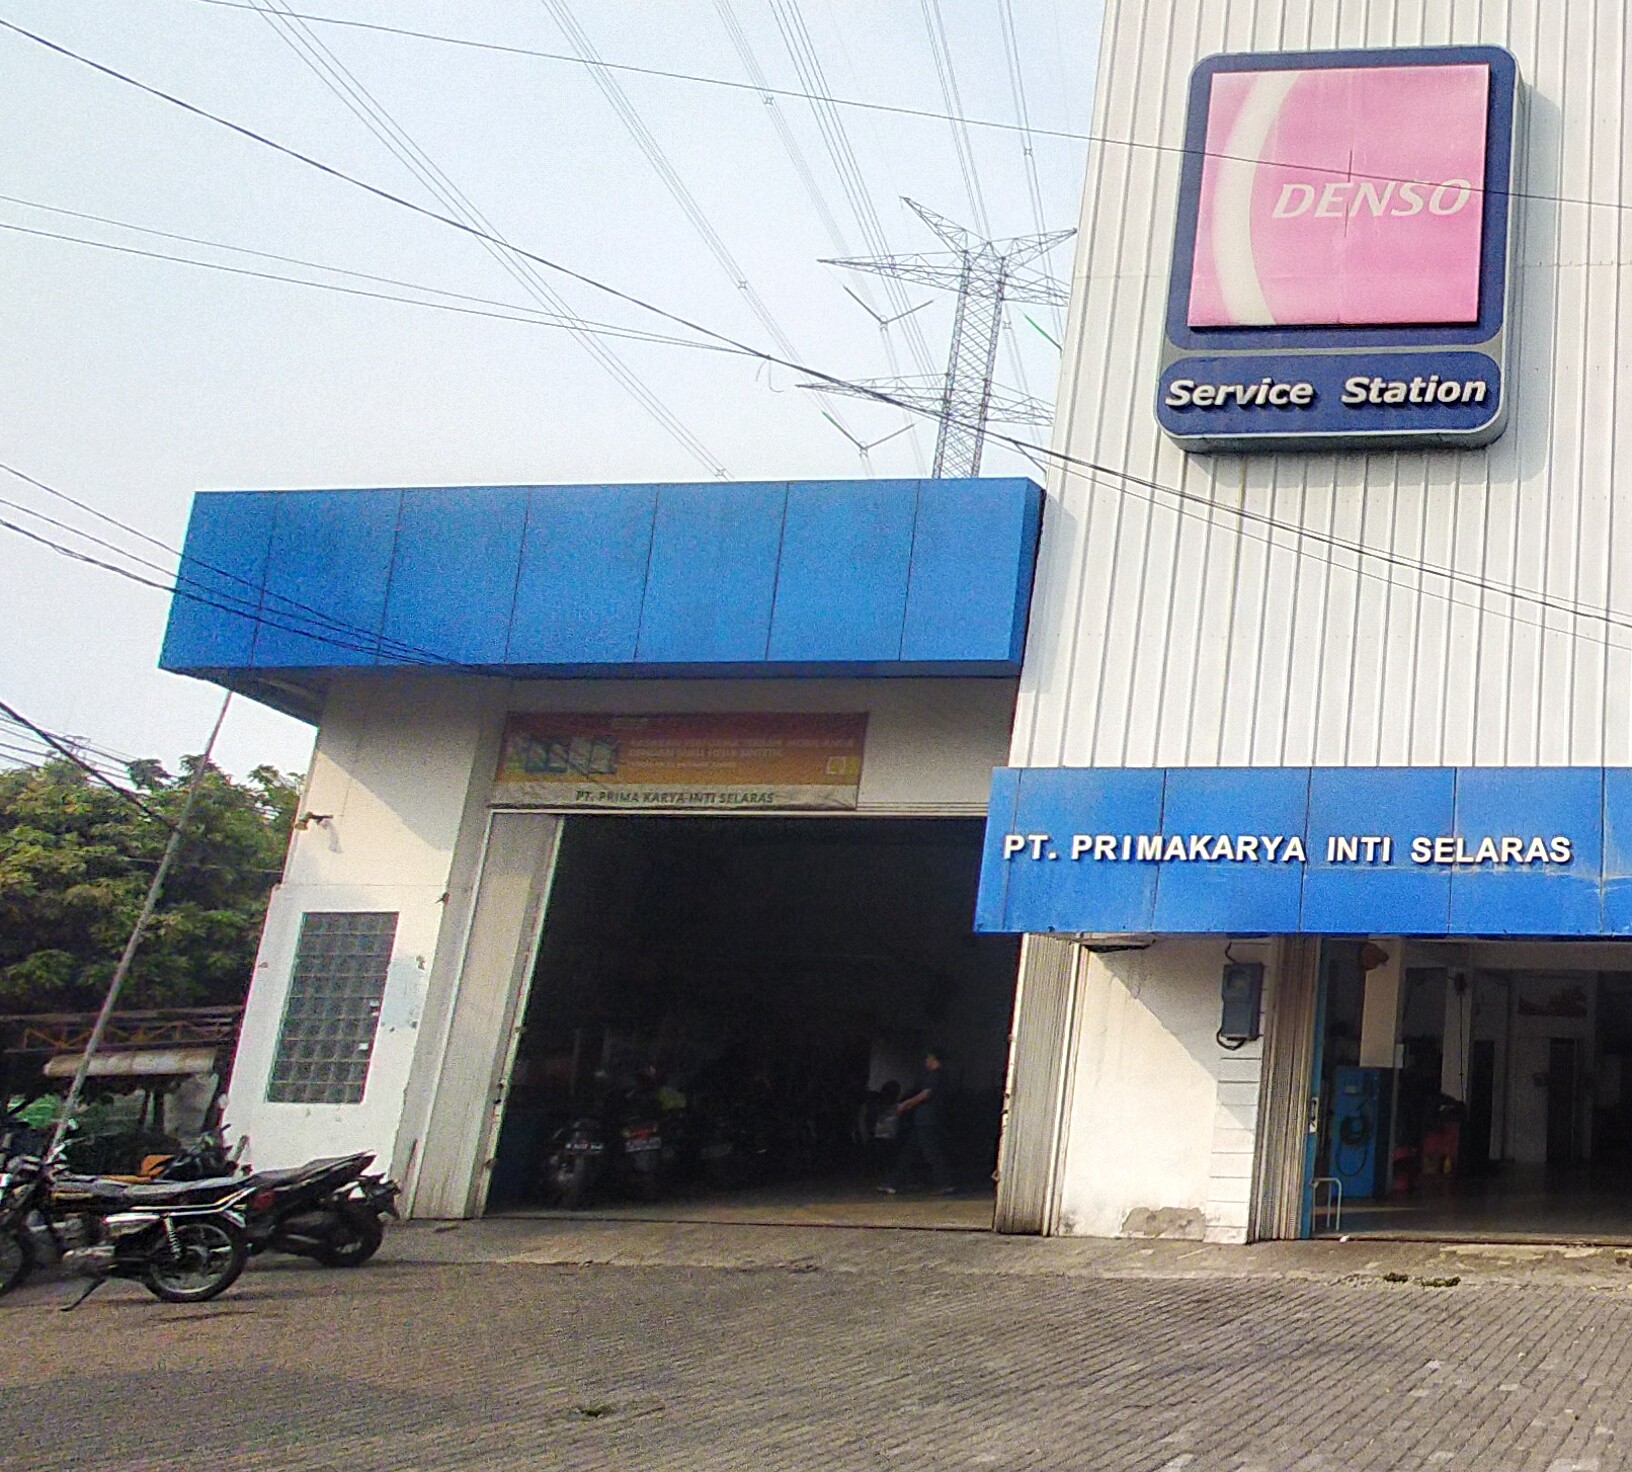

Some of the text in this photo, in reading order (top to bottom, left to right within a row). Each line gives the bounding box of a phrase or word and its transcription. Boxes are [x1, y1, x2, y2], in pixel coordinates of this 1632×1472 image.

[1272, 178, 1473, 219] DENSO
[1164, 374, 1486, 408] Service Station
[599, 791, 640, 804] PRIMA
[719, 792, 774, 804] SELARAS
[1003, 834, 1572, 864] PT. PRIMAKARYA INTI SELARAS
